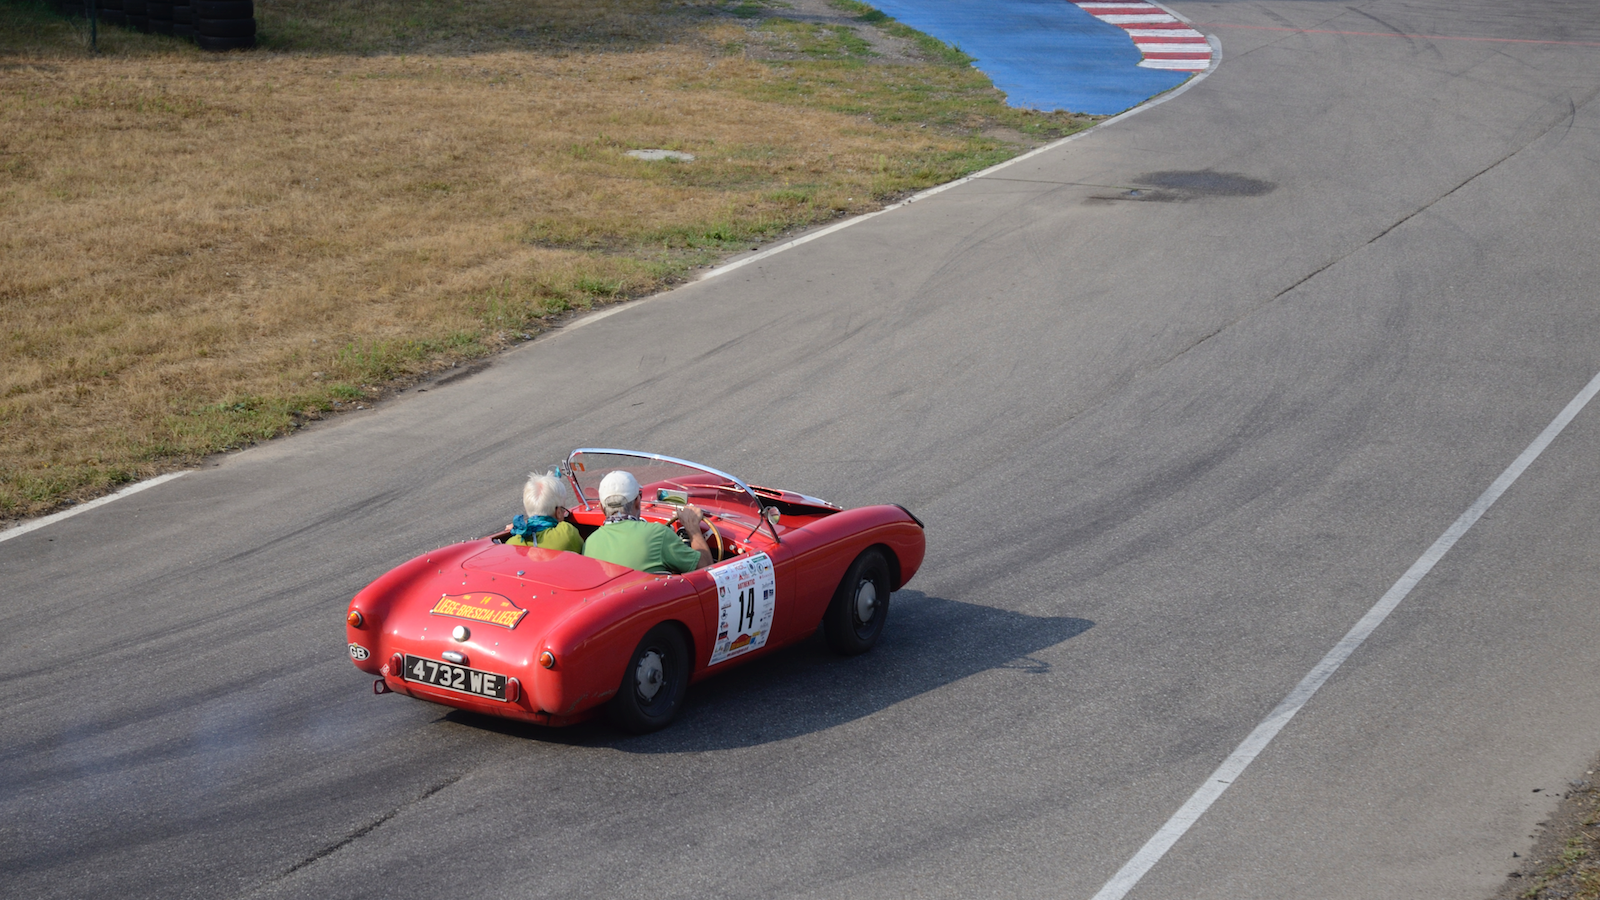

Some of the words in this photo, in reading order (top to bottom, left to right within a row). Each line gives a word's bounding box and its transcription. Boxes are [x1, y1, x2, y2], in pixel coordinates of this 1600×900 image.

[480, 596, 492, 605] 14
[738, 588, 755, 632] 14
[349, 645, 366, 659] GB
[412, 660, 465, 689] 4732
[470, 671, 497, 696] WE
